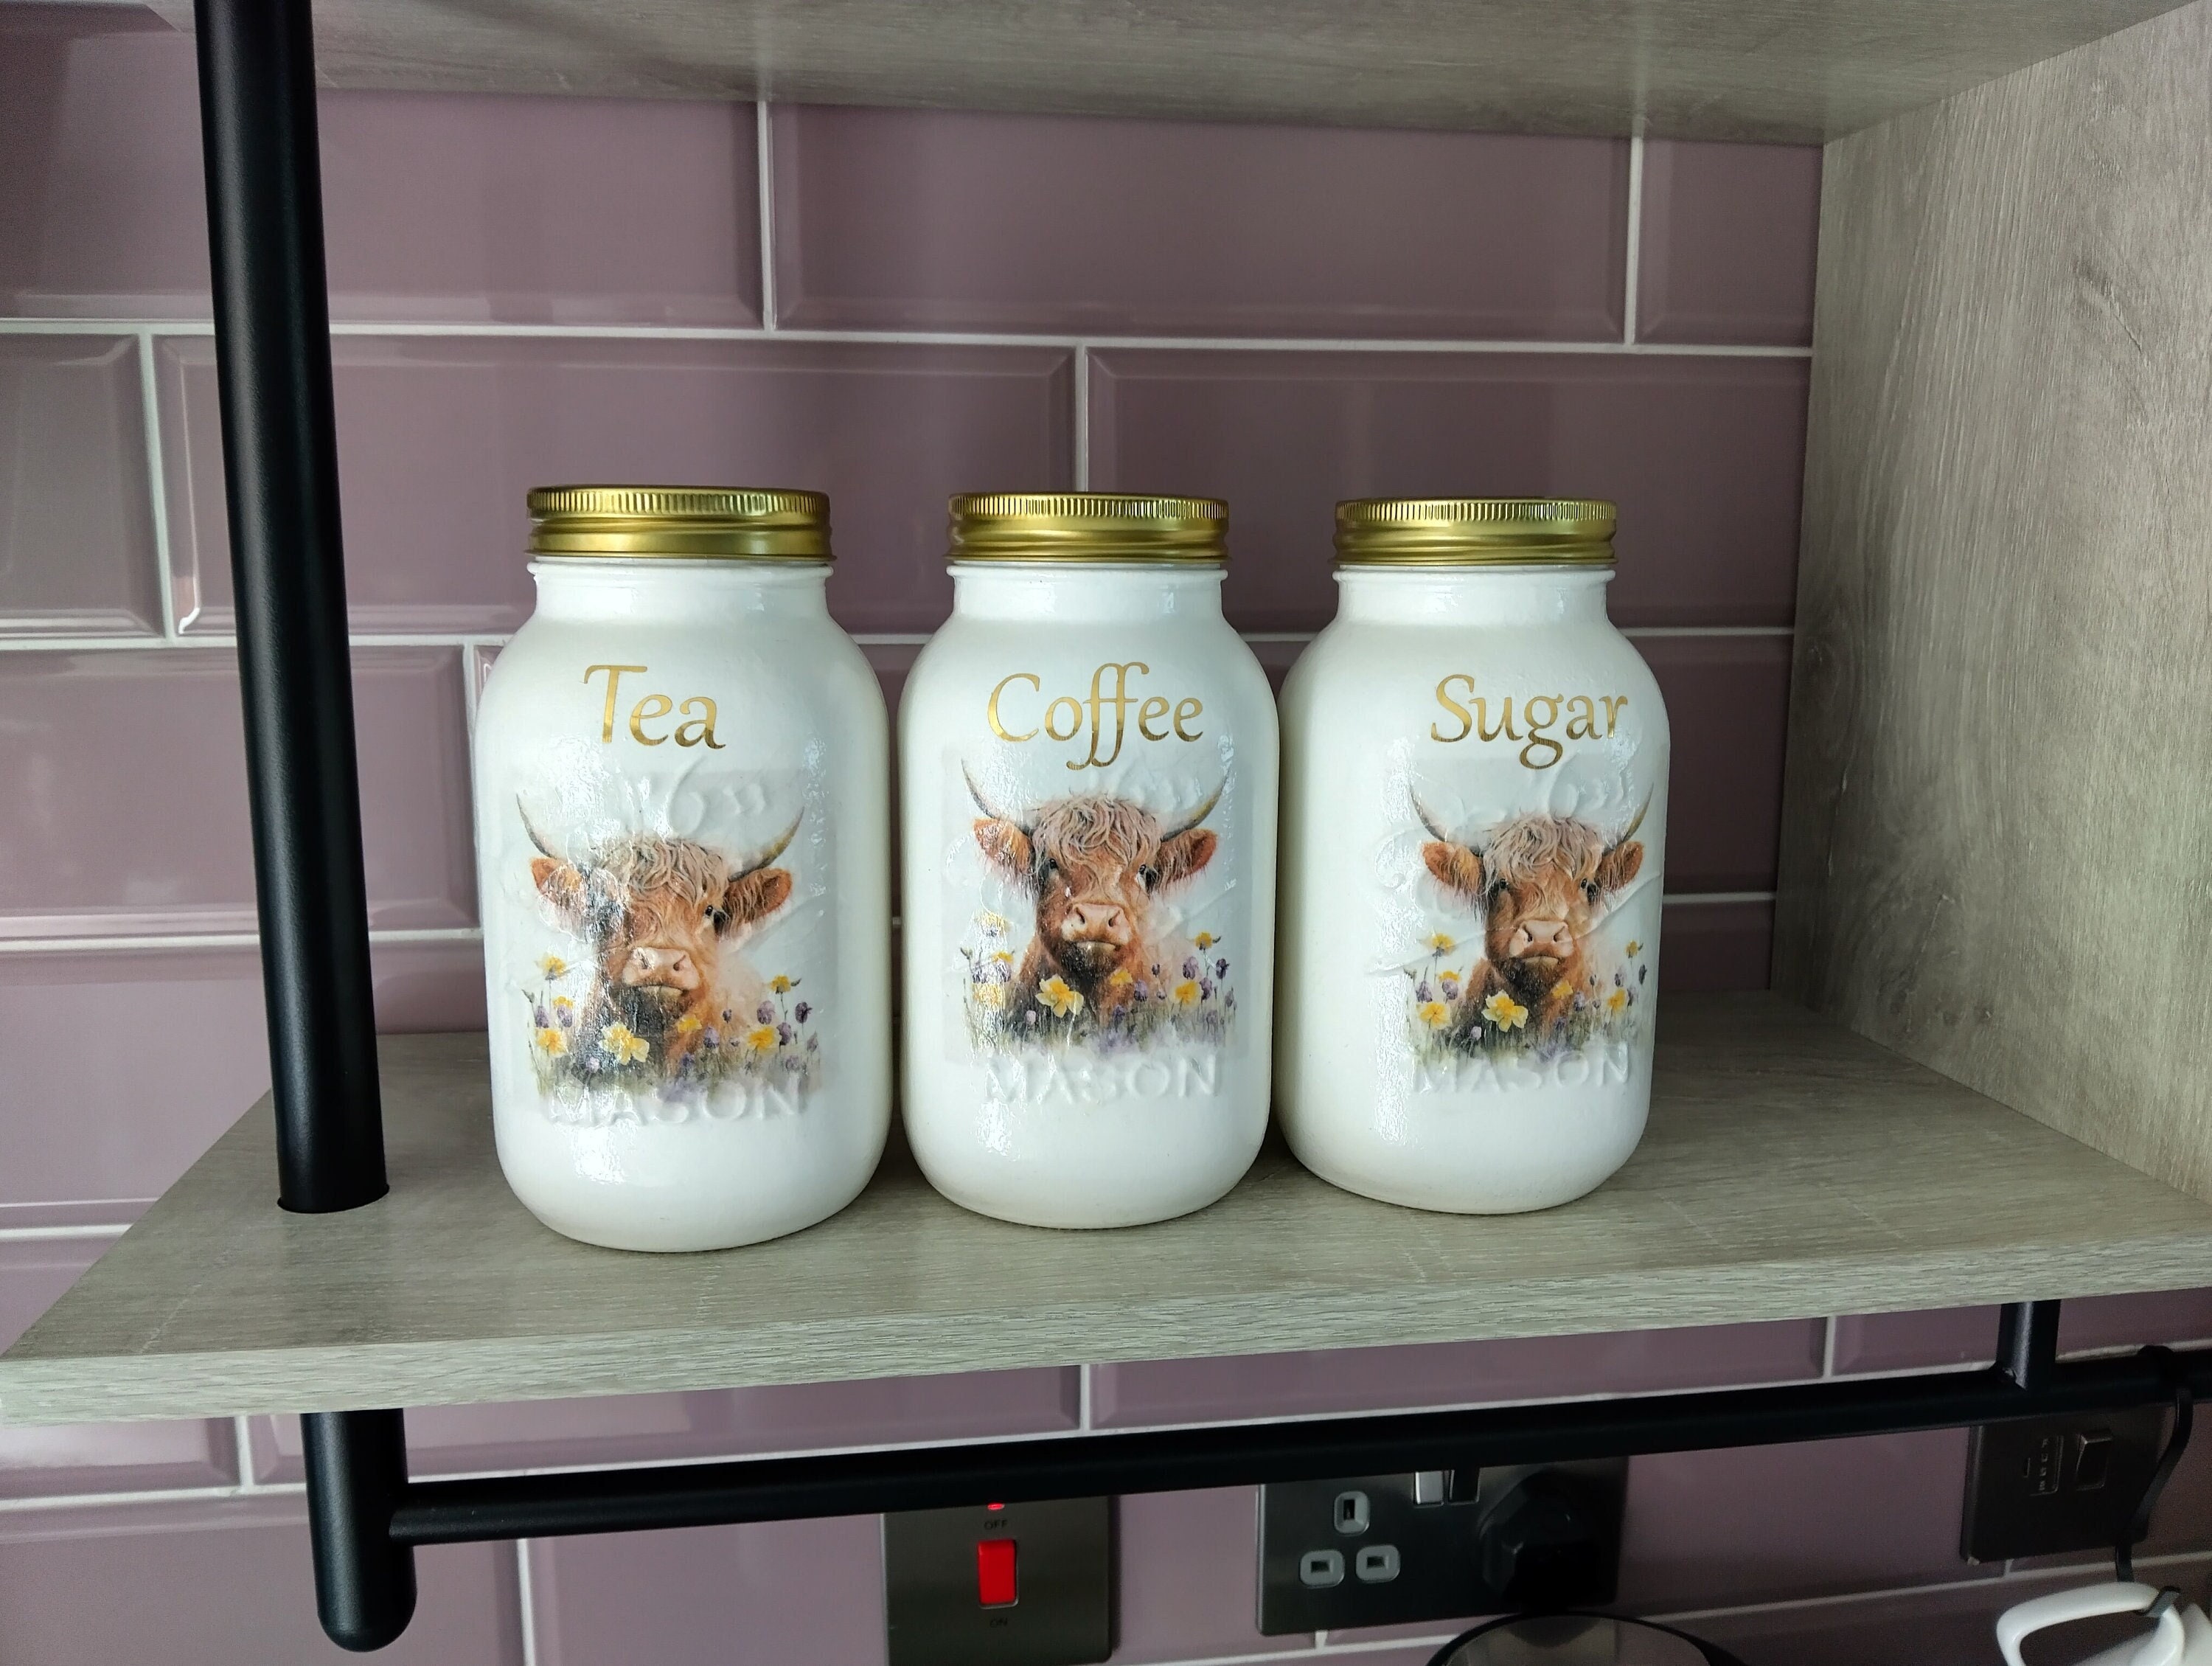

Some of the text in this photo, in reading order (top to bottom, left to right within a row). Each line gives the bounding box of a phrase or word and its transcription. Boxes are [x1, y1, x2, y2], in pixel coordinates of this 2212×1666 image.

[584, 664, 726, 749] Tea
[987, 662, 1203, 770] Coffee
[1431, 674, 1628, 769] Sugar
[984, 1520, 1007, 1530] OFF
[990, 1618, 1008, 1627] ON
